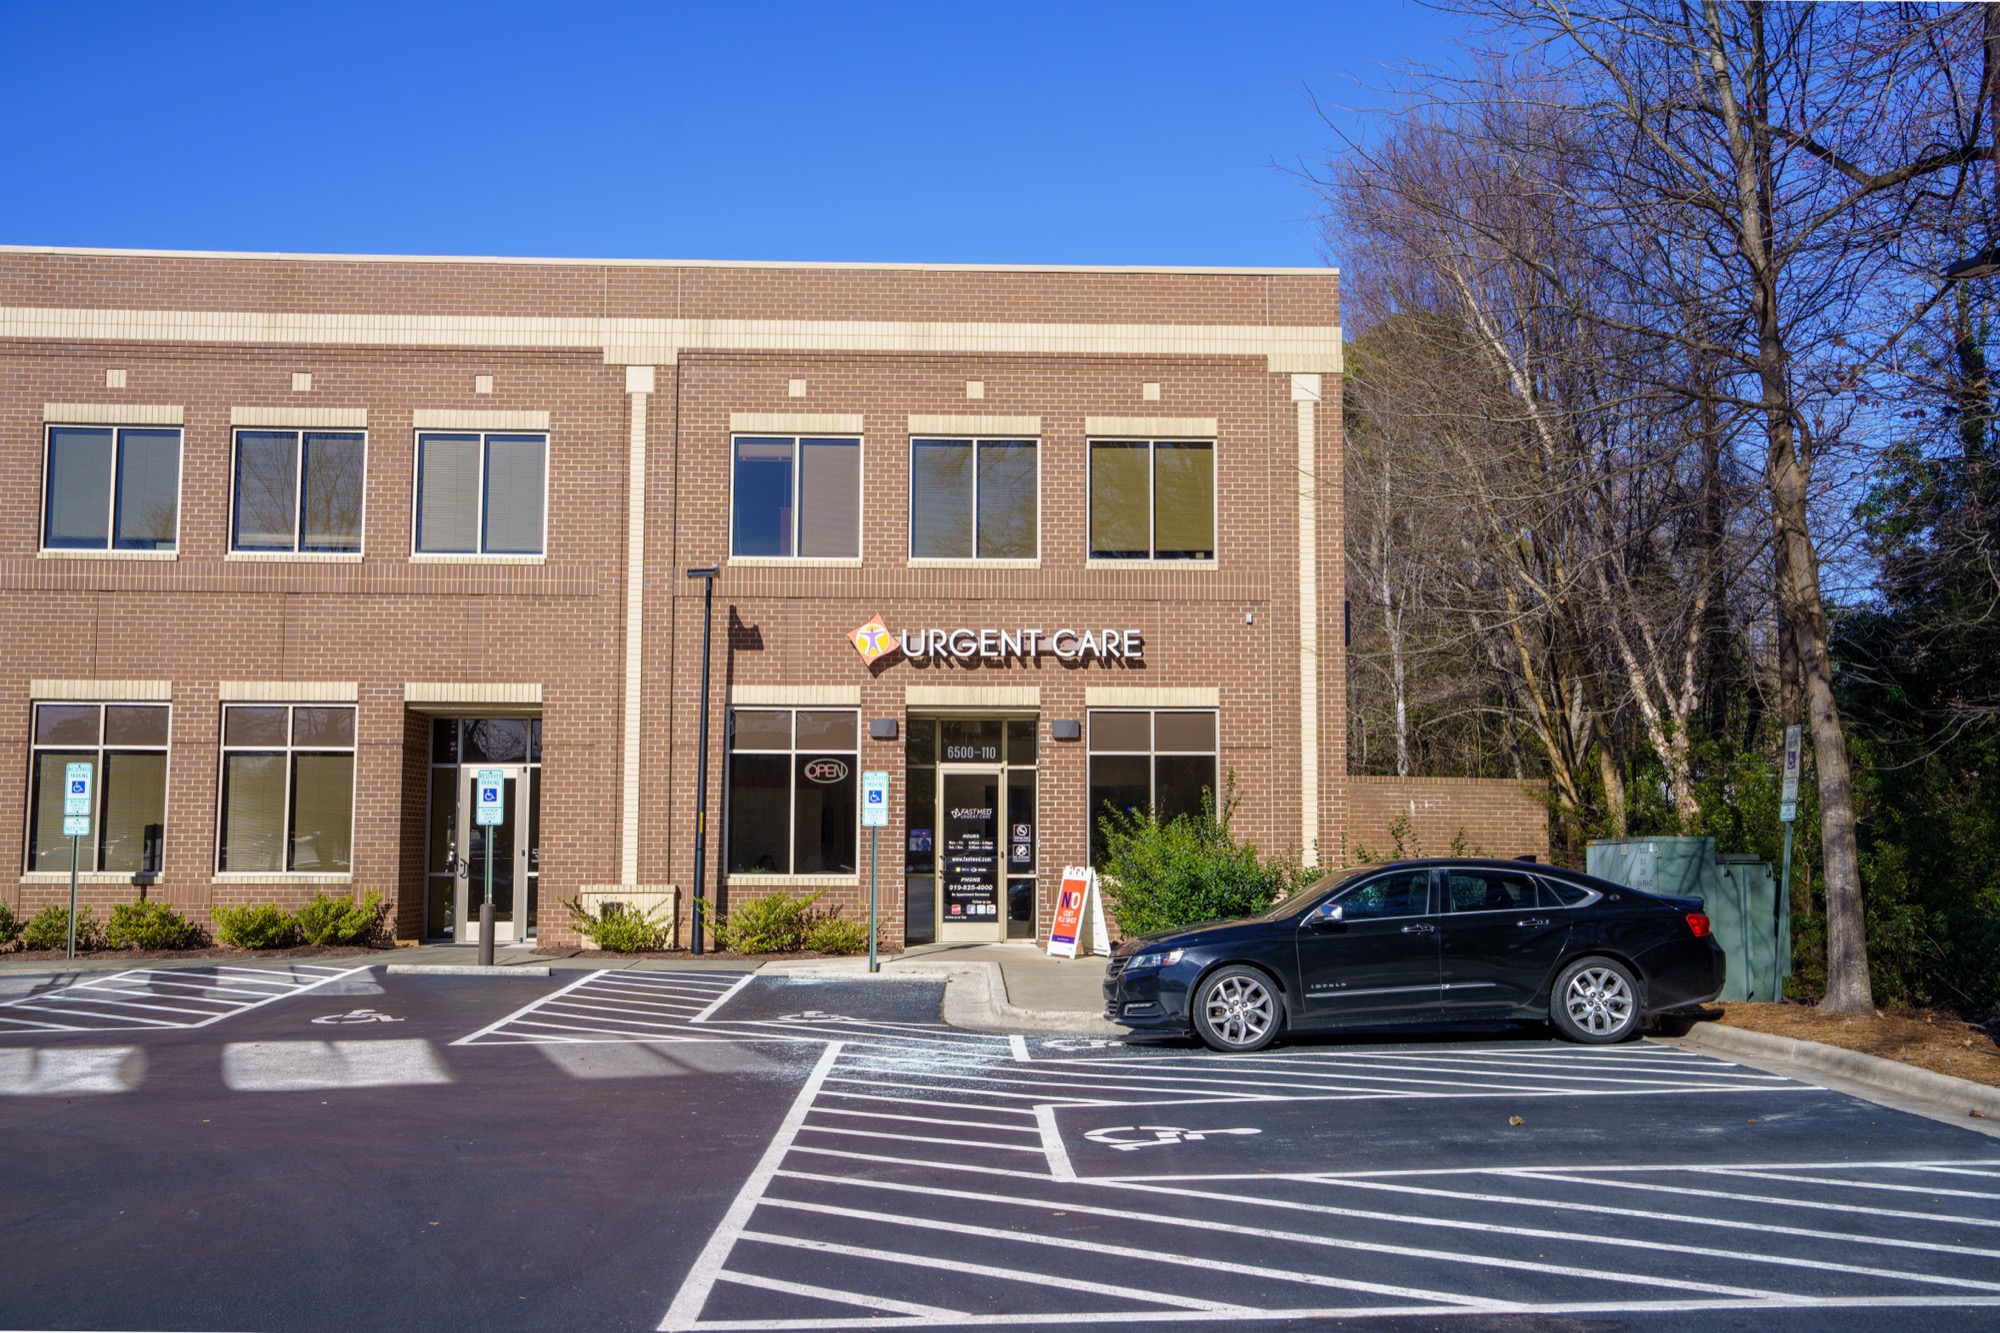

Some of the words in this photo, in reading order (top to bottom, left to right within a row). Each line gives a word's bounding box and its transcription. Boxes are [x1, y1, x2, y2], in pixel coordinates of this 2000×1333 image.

[901, 628, 1043, 658] URGENT
[1051, 628, 1143, 658] CARE
[947, 746, 996, 760] 6500-110
[807, 763, 843, 778] OPEN
[1062, 891, 1081, 910] NO
